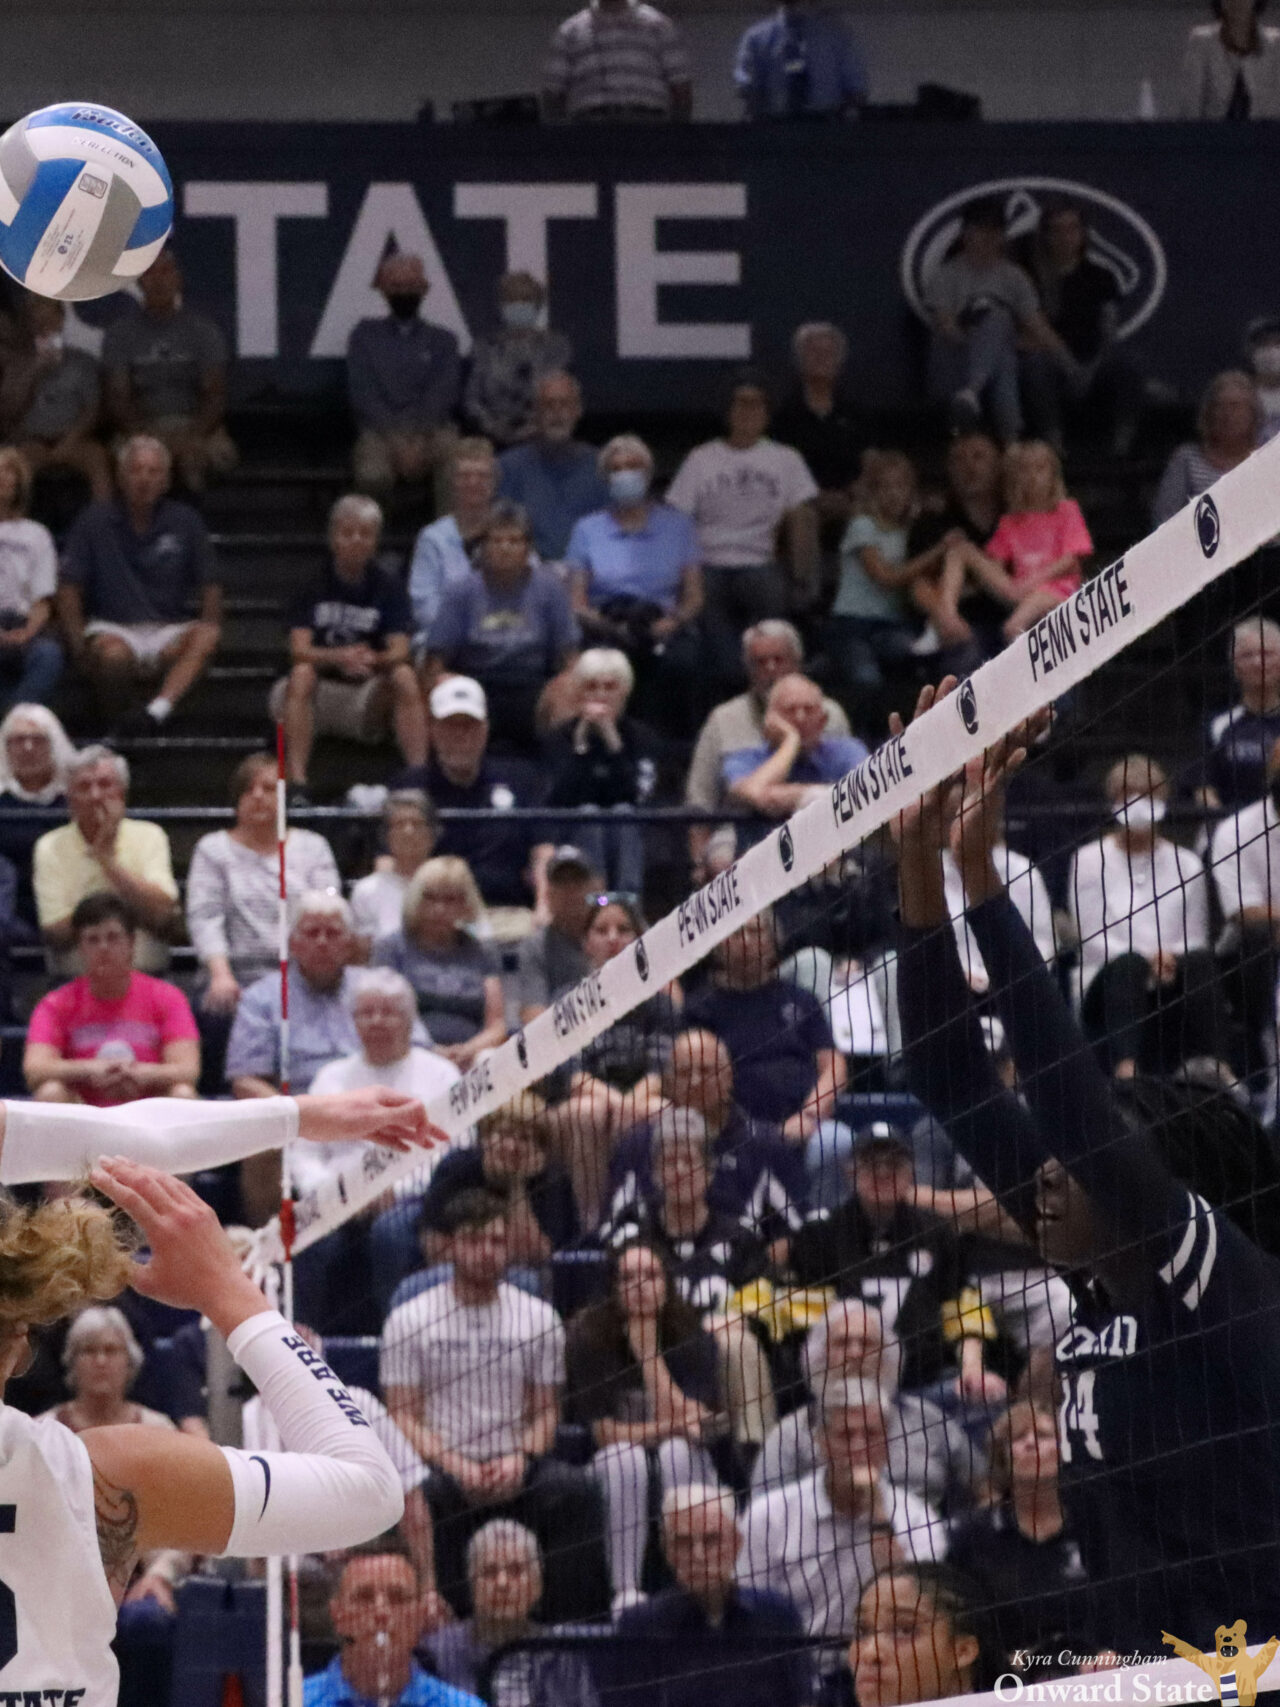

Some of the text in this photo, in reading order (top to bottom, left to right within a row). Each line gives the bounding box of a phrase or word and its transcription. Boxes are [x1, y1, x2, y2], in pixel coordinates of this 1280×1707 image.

[65, 181, 751, 358] TATE
[1027, 557, 1131, 683] PENN STATE
[832, 731, 913, 829] PENN STATE
[678, 864, 740, 948] PENN STATE
[281, 1334, 371, 1428] WE ARE
[1059, 1370, 1103, 1463] 14
